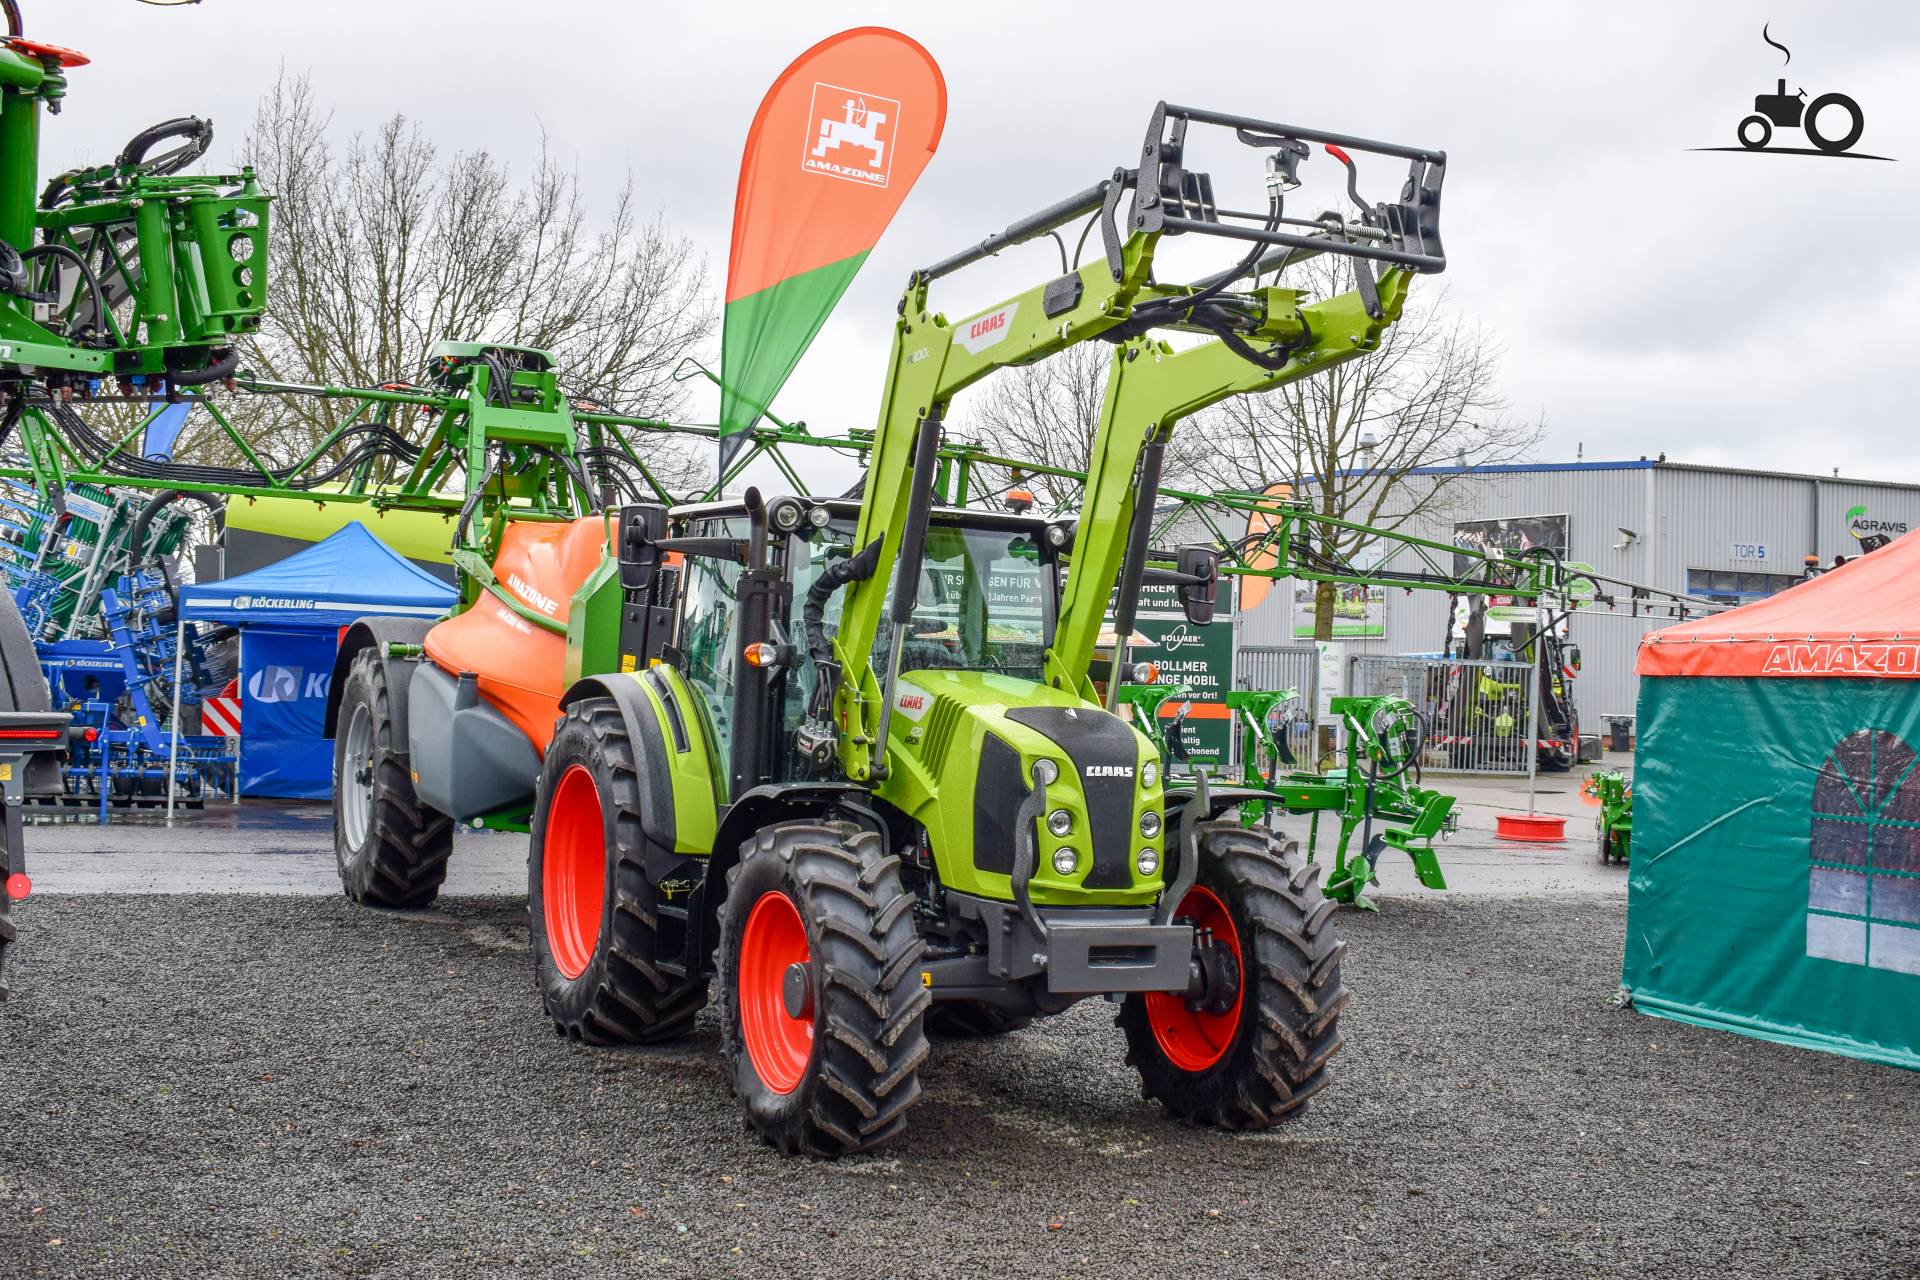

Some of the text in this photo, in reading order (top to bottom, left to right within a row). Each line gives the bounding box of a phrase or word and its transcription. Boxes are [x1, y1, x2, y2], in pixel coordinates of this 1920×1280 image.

[805, 159, 885, 183] AMAZONE
[969, 311, 1006, 339] CLAAS
[1851, 519, 1907, 534] AGRAVIS
[1733, 544, 1765, 559] TOR 5
[1009, 575, 1031, 589] FÜR
[507, 573, 559, 615] AMAZONE
[991, 592, 1019, 602] Jahren
[251, 596, 315, 609] KÖCKERLING
[1152, 598, 1169, 607] und
[1160, 634, 1199, 643] BOLLMER
[76, 659, 114, 668] KÖCKERLING
[1762, 644, 1920, 674] AMAZO
[1153, 660, 1208, 672] BOLLMER
[1183, 675, 1219, 686] MOBIL
[898, 694, 924, 710] CLAAS
[1202, 692, 1218, 700] Ort!
[1085, 765, 1134, 778] CLAAS
